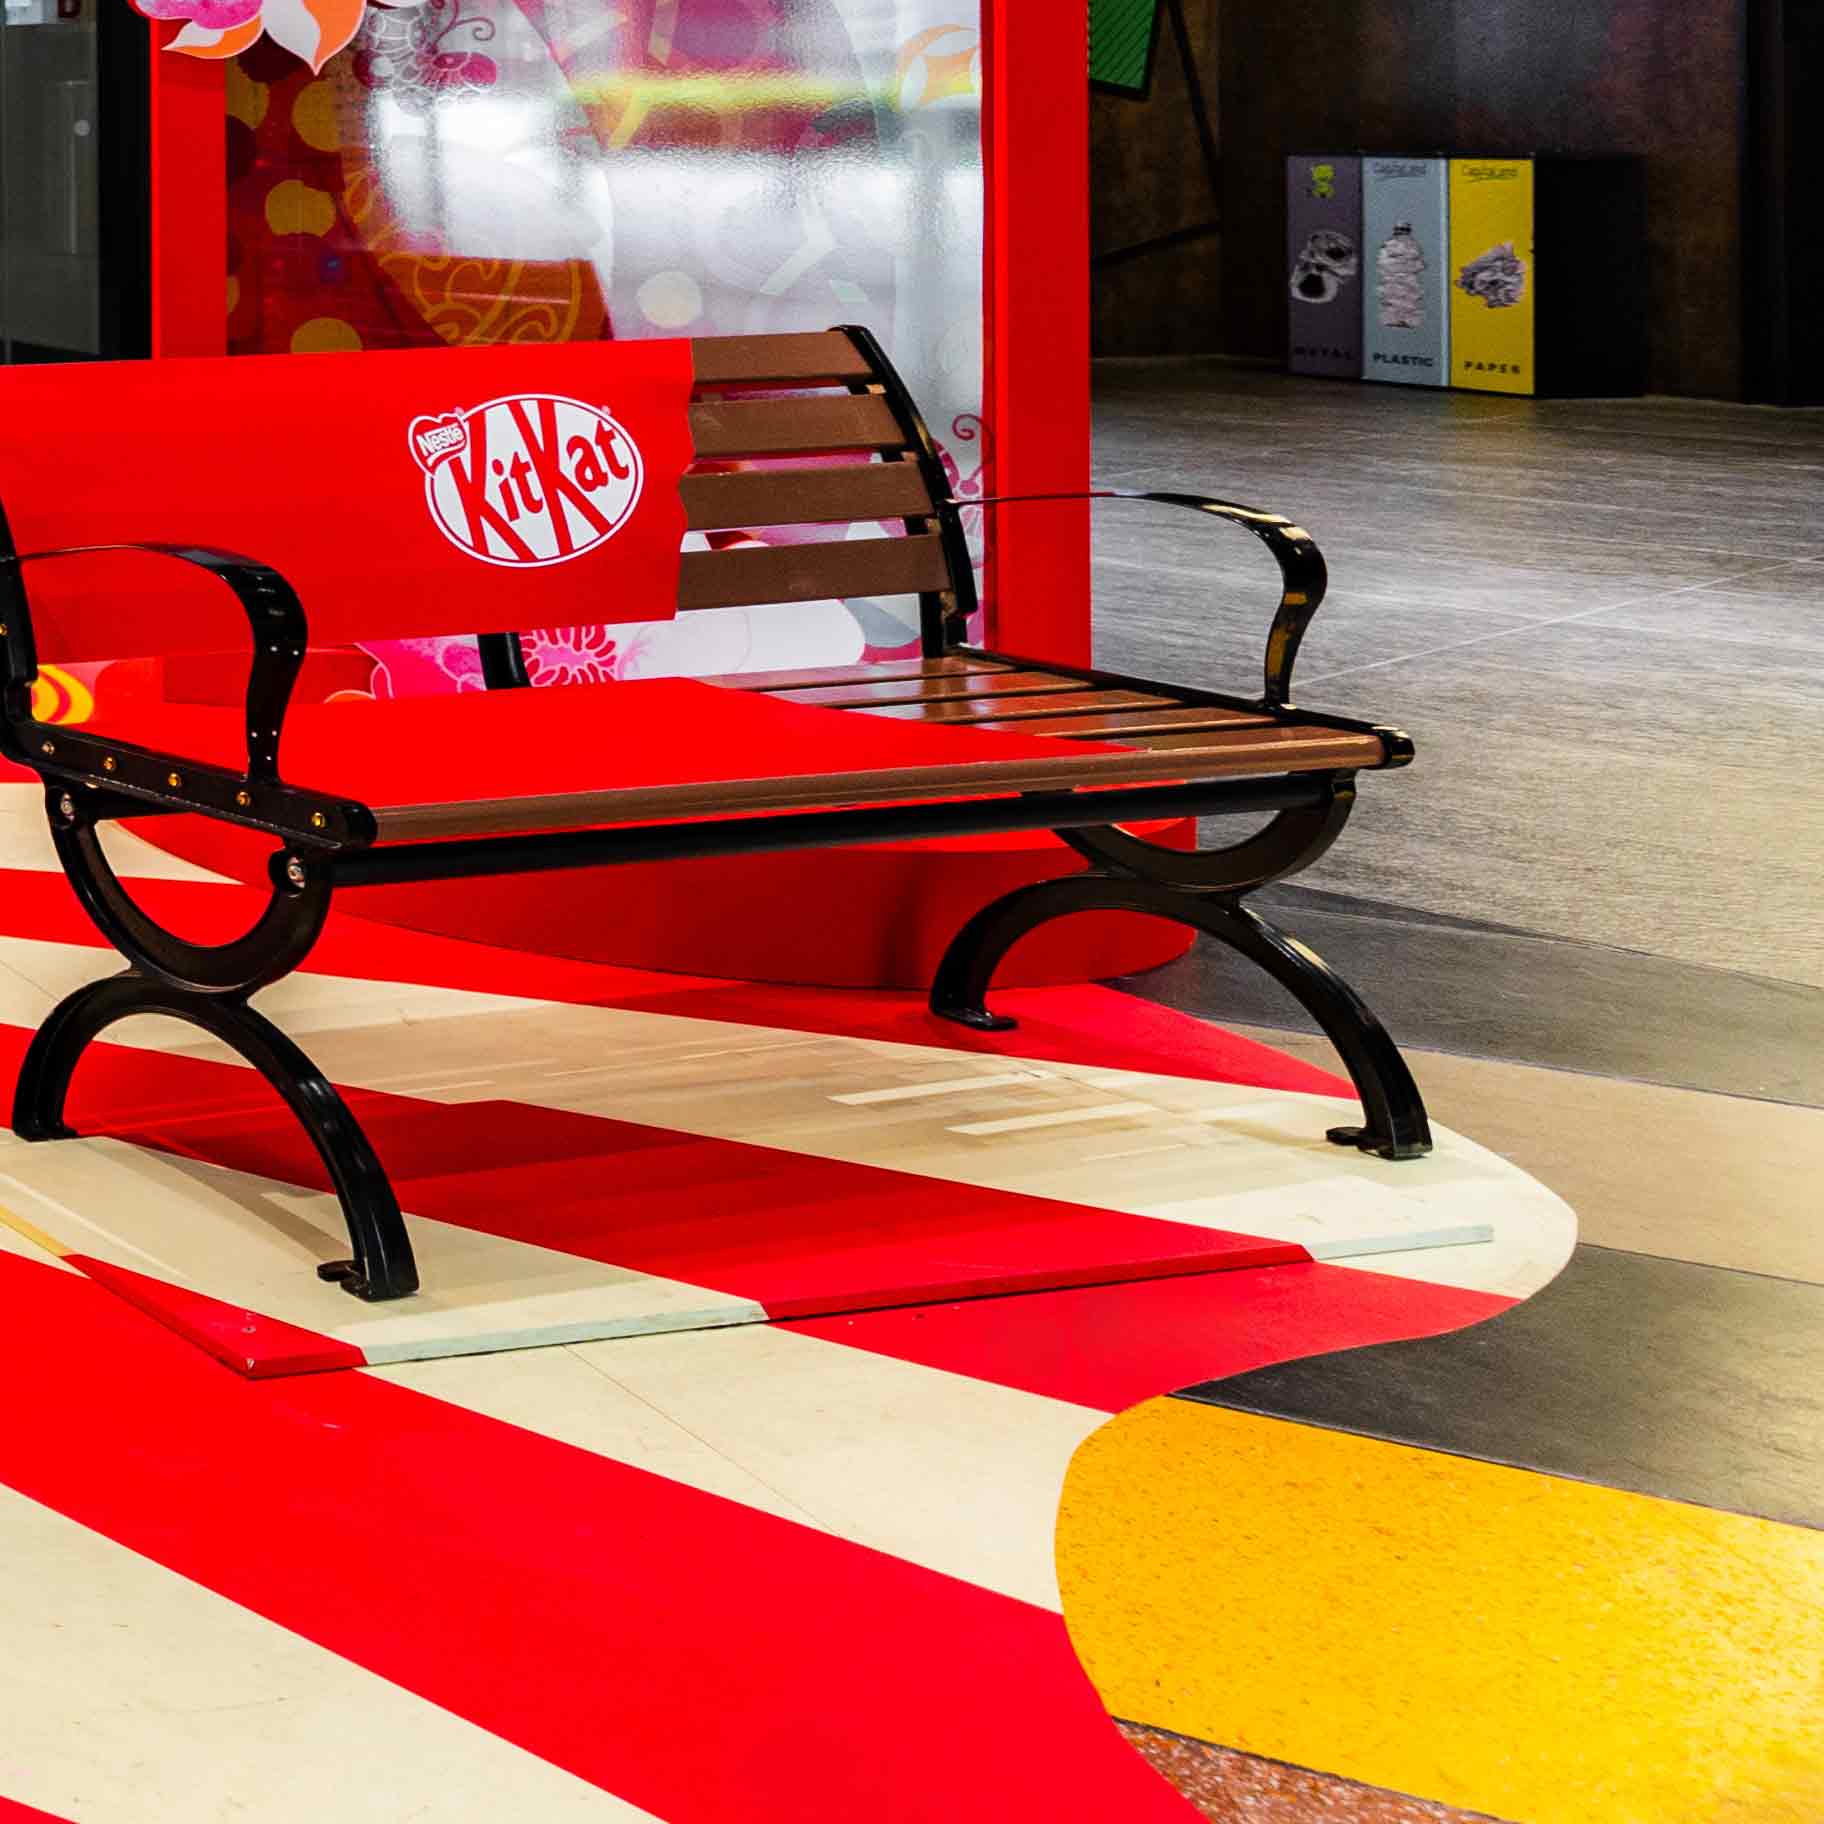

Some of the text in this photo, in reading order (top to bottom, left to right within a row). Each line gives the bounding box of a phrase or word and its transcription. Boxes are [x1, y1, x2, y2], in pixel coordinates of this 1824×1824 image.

[1372, 353, 1434, 368] PLASTIC
[1463, 360, 1521, 375] PAPER
[416, 419, 466, 457] Nestlé
[448, 401, 630, 559] KitKat
